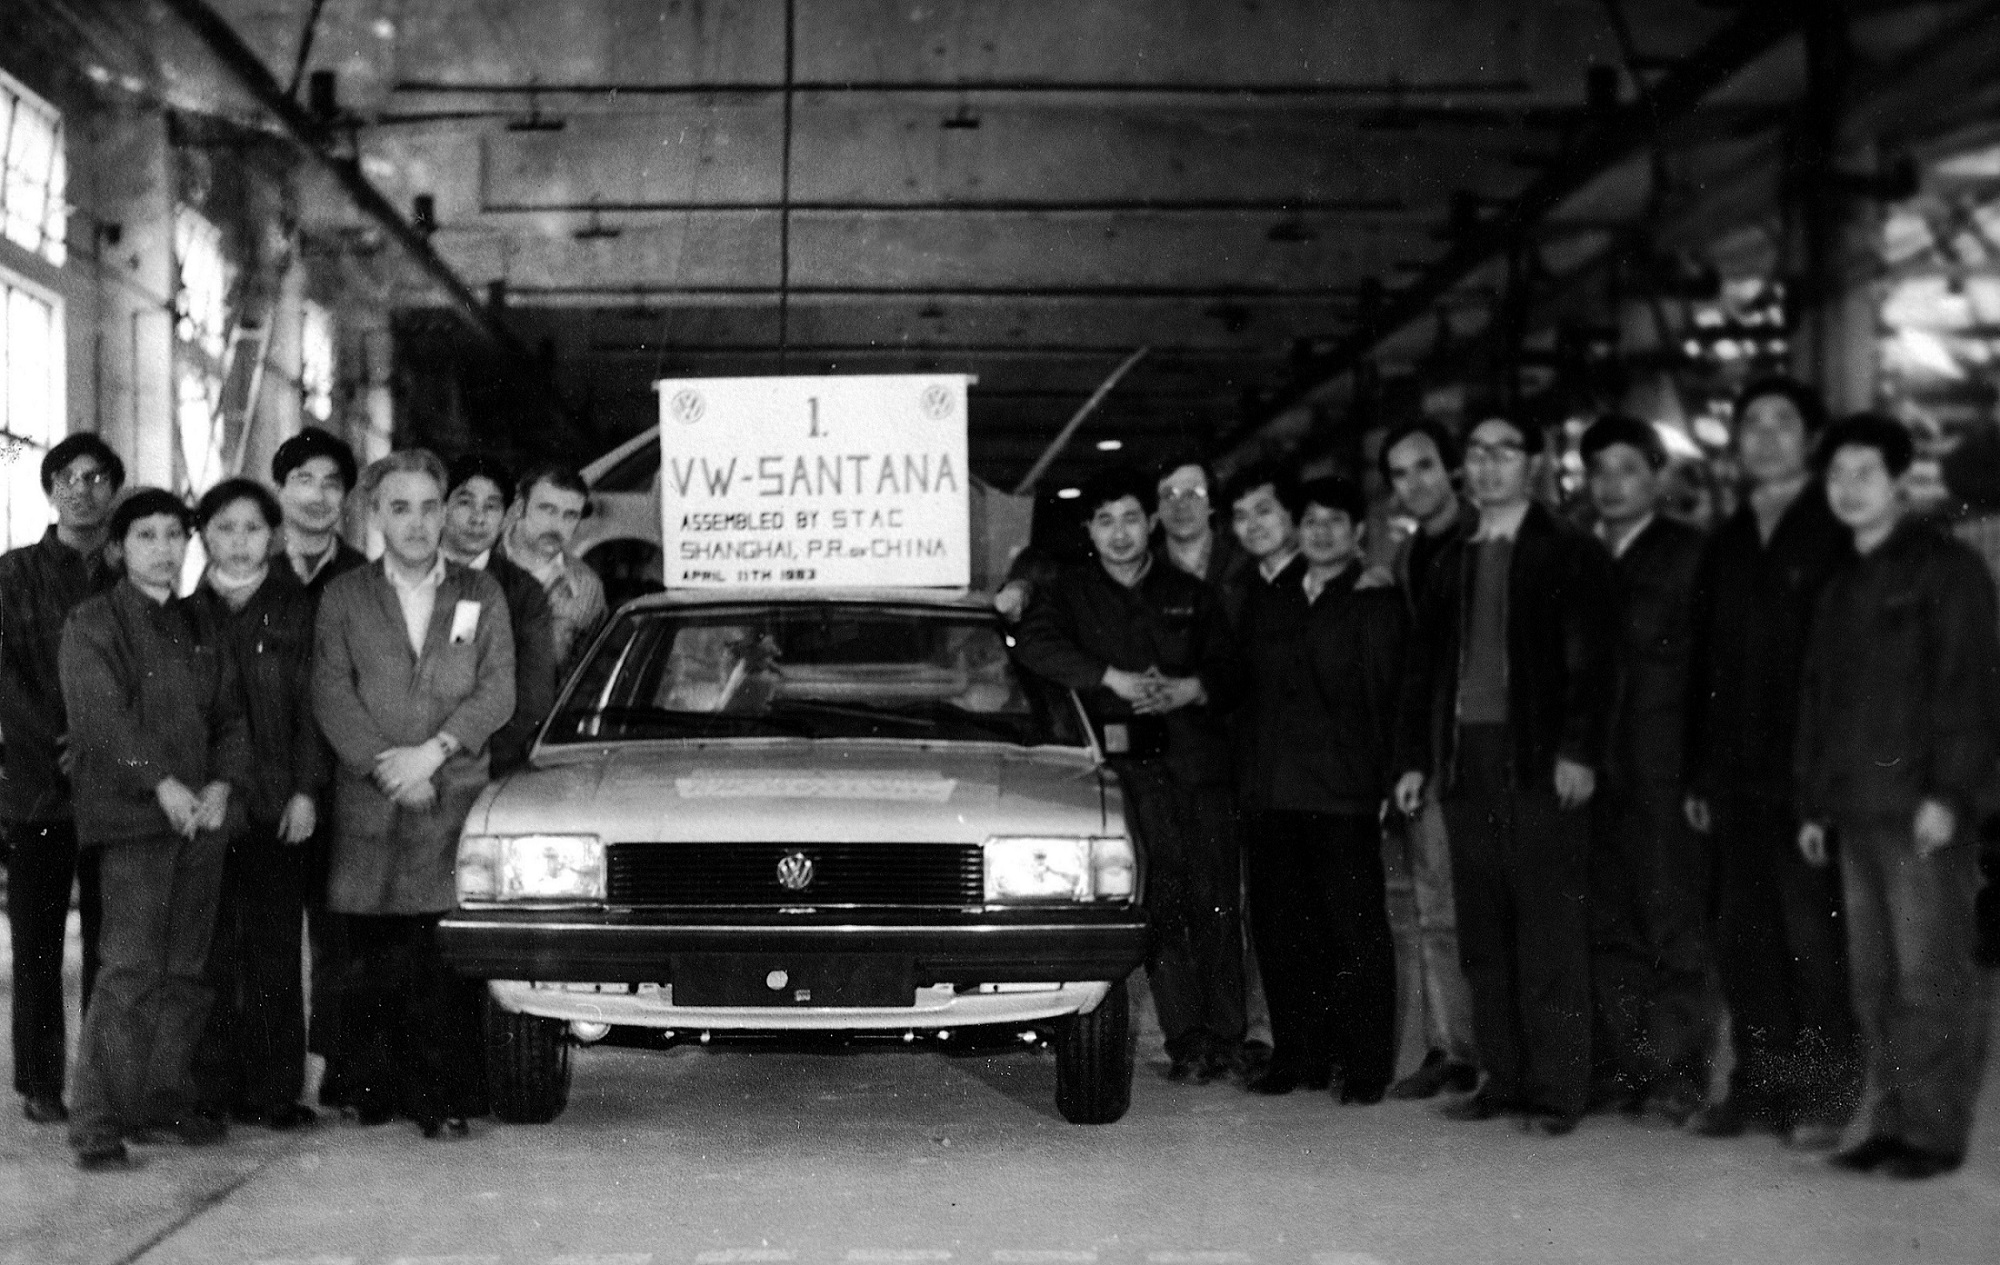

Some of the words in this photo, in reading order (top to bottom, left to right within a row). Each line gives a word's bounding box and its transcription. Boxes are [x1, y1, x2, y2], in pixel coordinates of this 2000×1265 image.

[807, 397, 828, 438] 1.
[671, 454, 957, 497] VW-SANTANA
[680, 512, 784, 532] ASSEMBLED
[797, 511, 819, 529] BY
[832, 509, 904, 528] STAC
[680, 541, 798, 561] SHANGHAI,
[870, 537, 949, 558] CHINA
[682, 570, 725, 582] APRIL
[737, 569, 772, 581] 11TH
[779, 568, 816, 581] 1983
